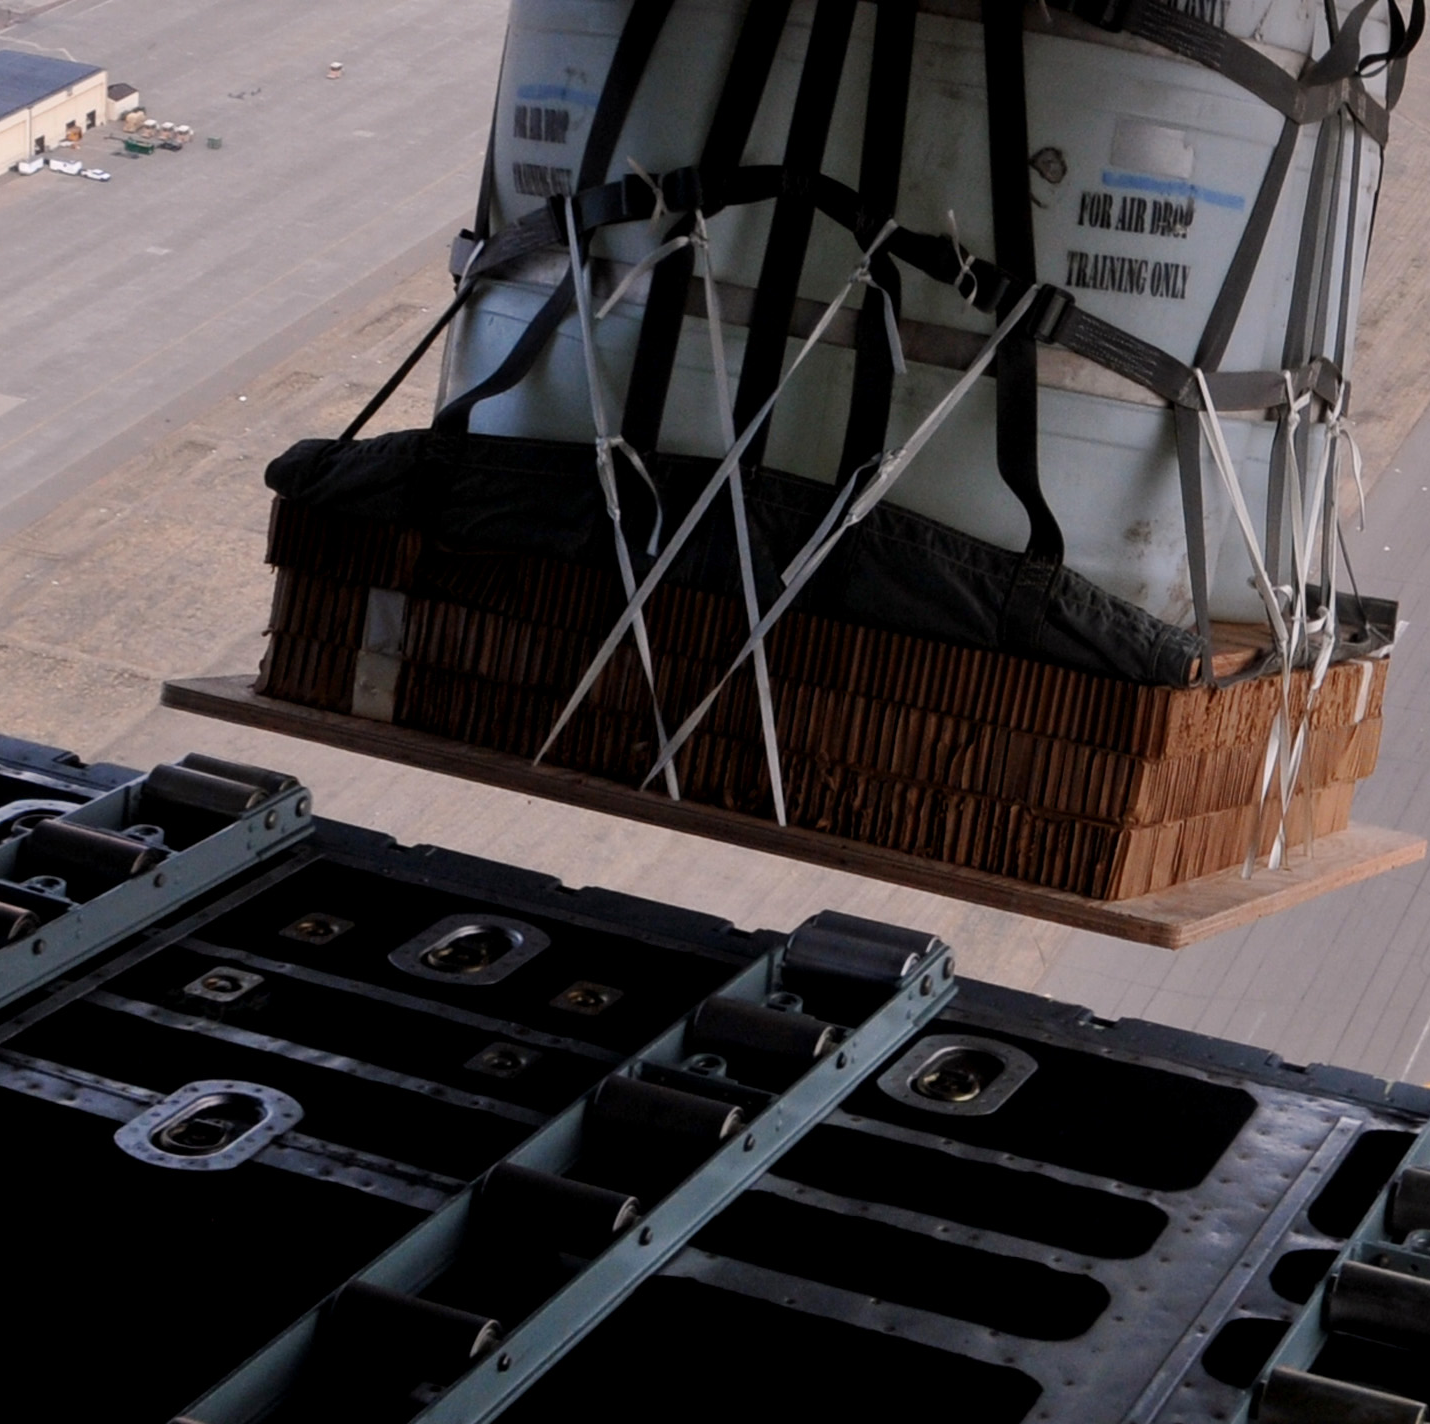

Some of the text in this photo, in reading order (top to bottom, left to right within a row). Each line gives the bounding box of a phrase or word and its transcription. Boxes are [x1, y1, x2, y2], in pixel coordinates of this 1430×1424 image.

[1077, 191, 1195, 239] FOR AIR DROP
[1065, 250, 1191, 299] TRAINING ONLY
